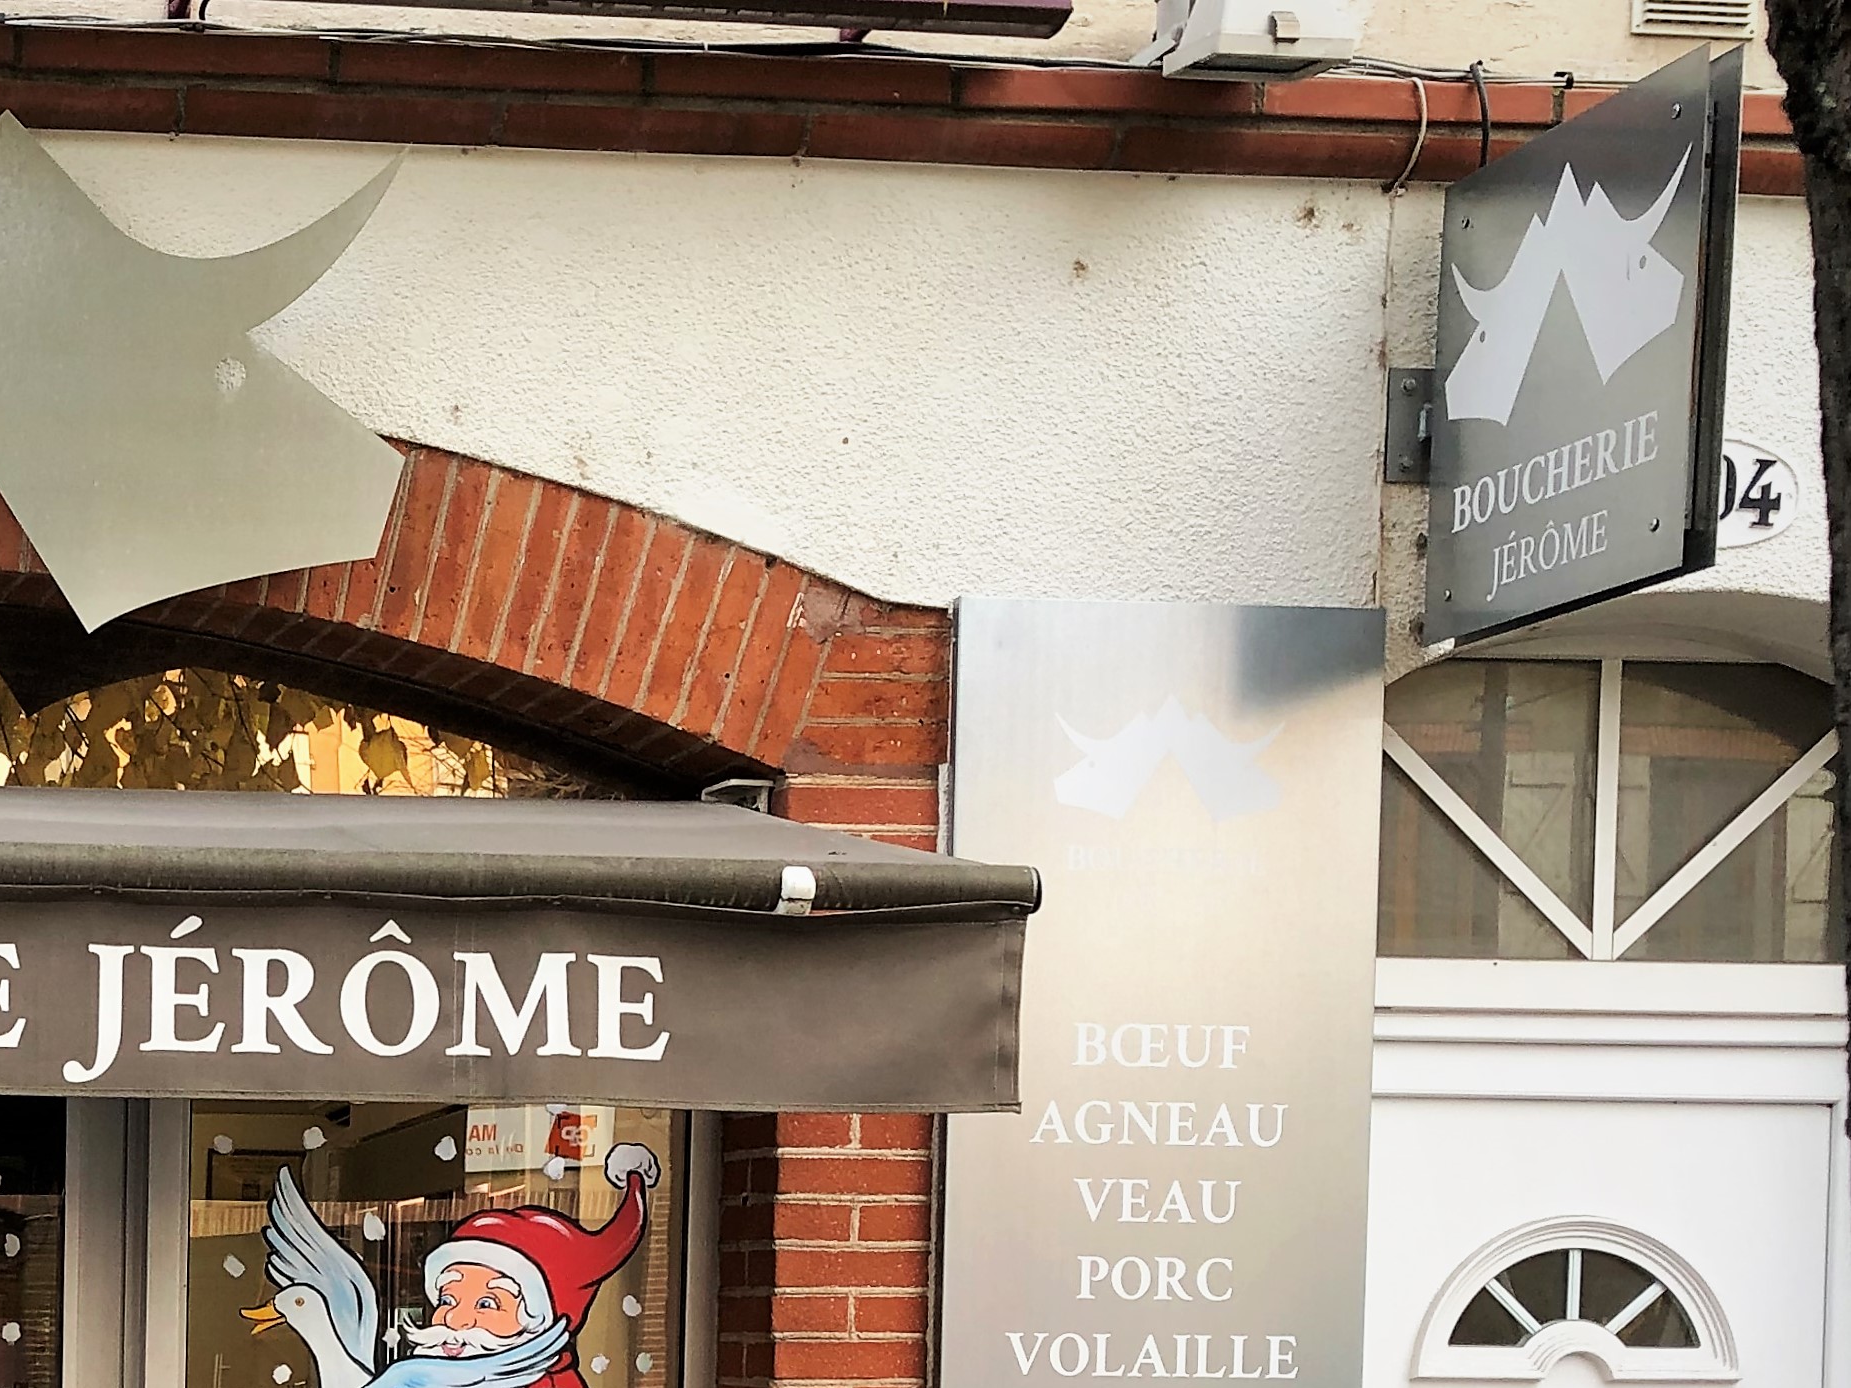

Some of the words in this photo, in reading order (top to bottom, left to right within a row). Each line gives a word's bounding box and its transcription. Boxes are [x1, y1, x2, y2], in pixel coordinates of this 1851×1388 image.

[1451, 410, 1659, 534] BOUCHERIE
[1486, 509, 1609, 602] JÉRÔME
[60, 914, 672, 1085] JÉRÔME
[1072, 1022, 1250, 1070] BŒUF
[1029, 1100, 1290, 1150] AGNEAU
[1073, 1177, 1242, 1225] VEAU
[1075, 1254, 1235, 1301] PORC
[1004, 1331, 1299, 1380] VOLAILLE
